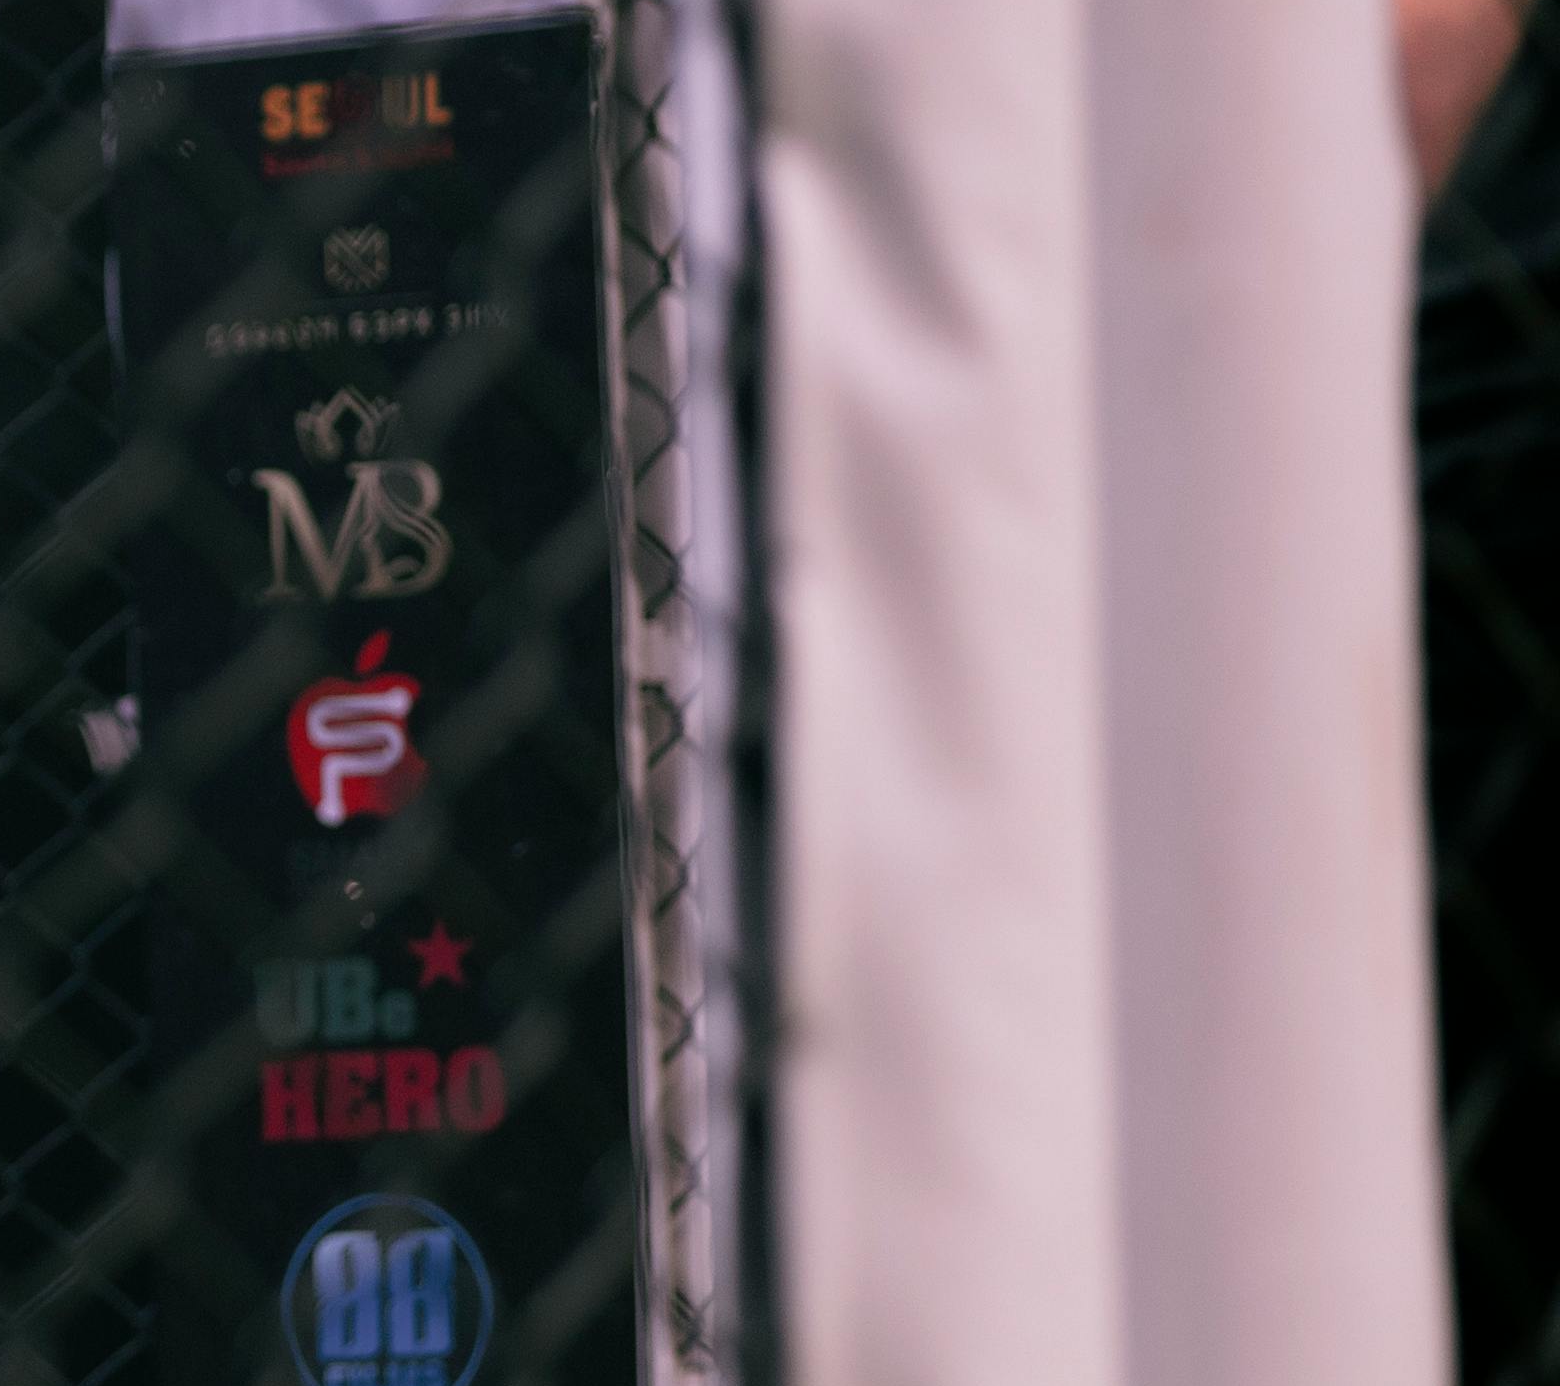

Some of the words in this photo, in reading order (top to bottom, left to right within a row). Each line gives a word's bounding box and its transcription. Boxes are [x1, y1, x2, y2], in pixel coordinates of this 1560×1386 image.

[261, 70, 453, 142] SEUL
[260, 1046, 507, 1142] HERO
[312, 1228, 460, 1359] 88
